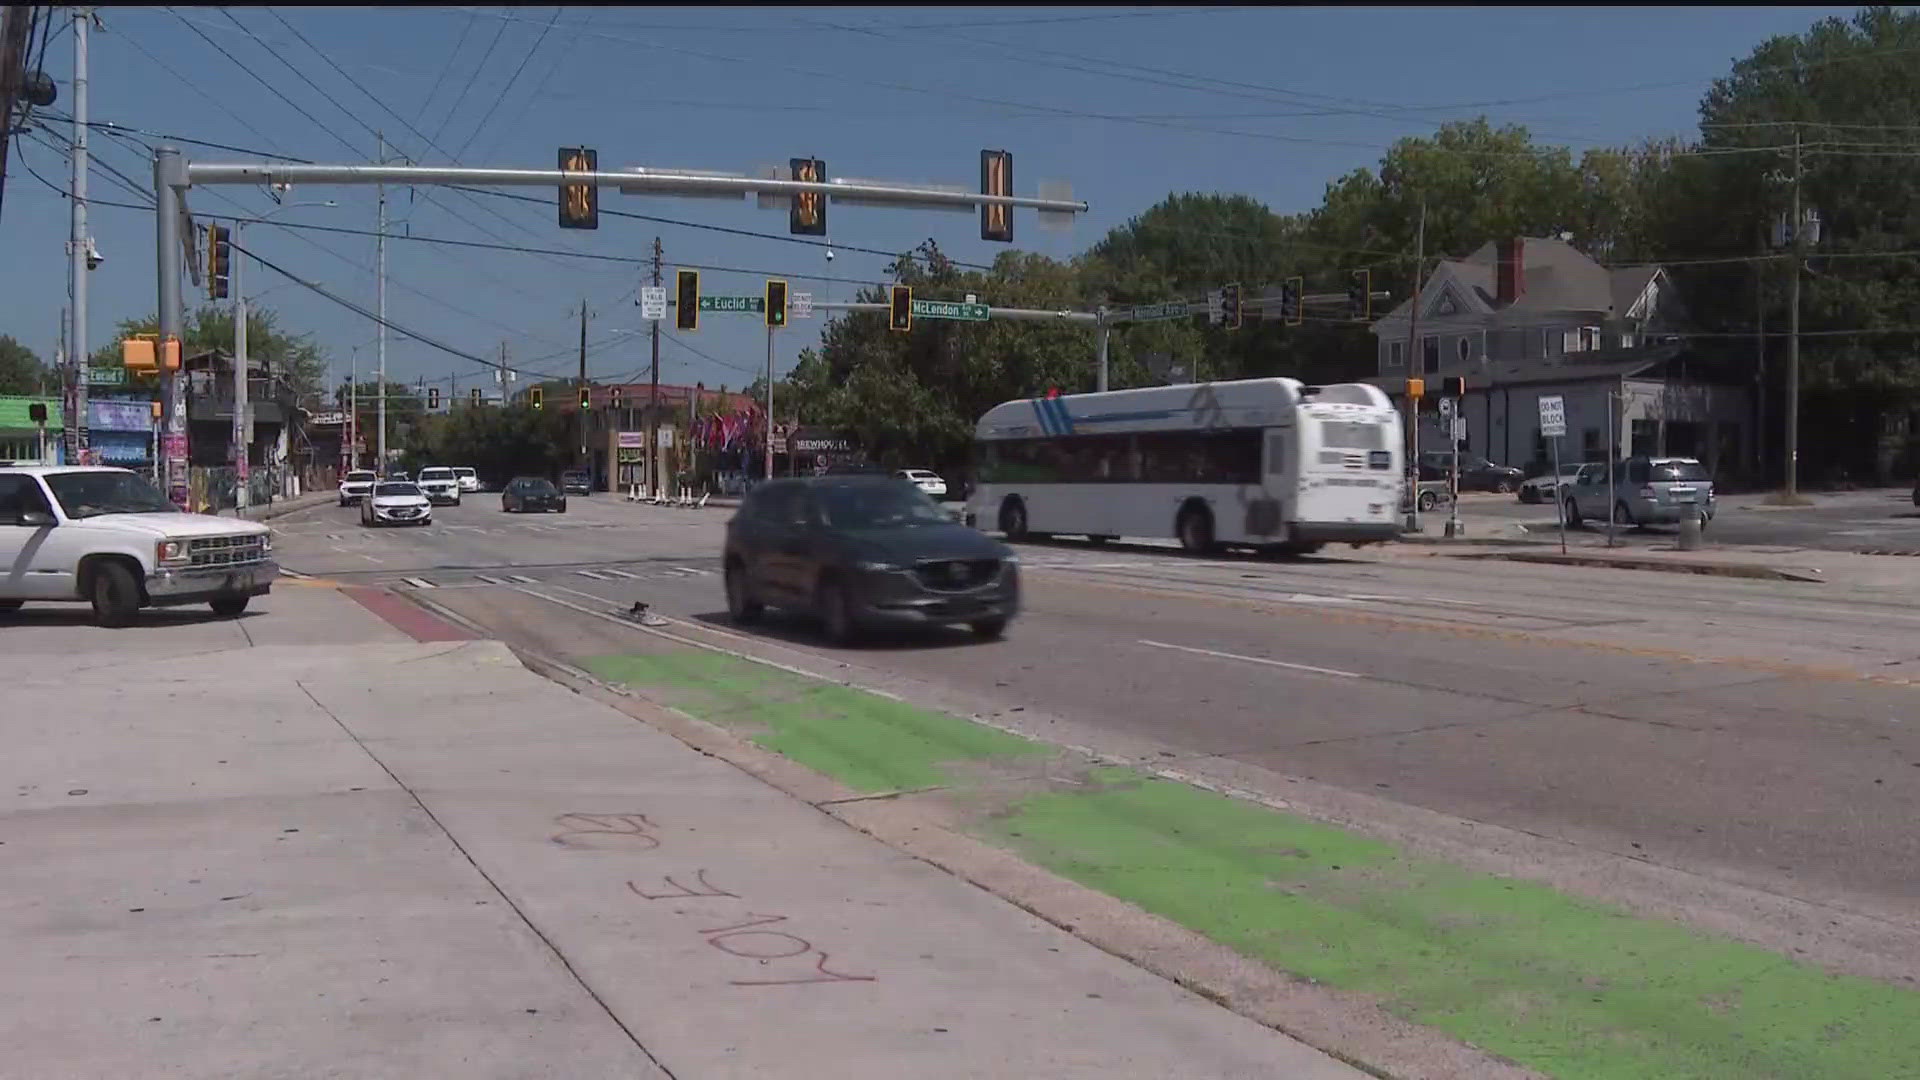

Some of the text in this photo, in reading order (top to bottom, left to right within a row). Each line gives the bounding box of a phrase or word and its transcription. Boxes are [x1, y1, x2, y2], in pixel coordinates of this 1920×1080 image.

[715, 298, 745, 309] Euclid
[913, 301, 959, 315] McLendon
[1541, 401, 1562, 411] DO NOT
[1542, 414, 1563, 424] BLOCK
